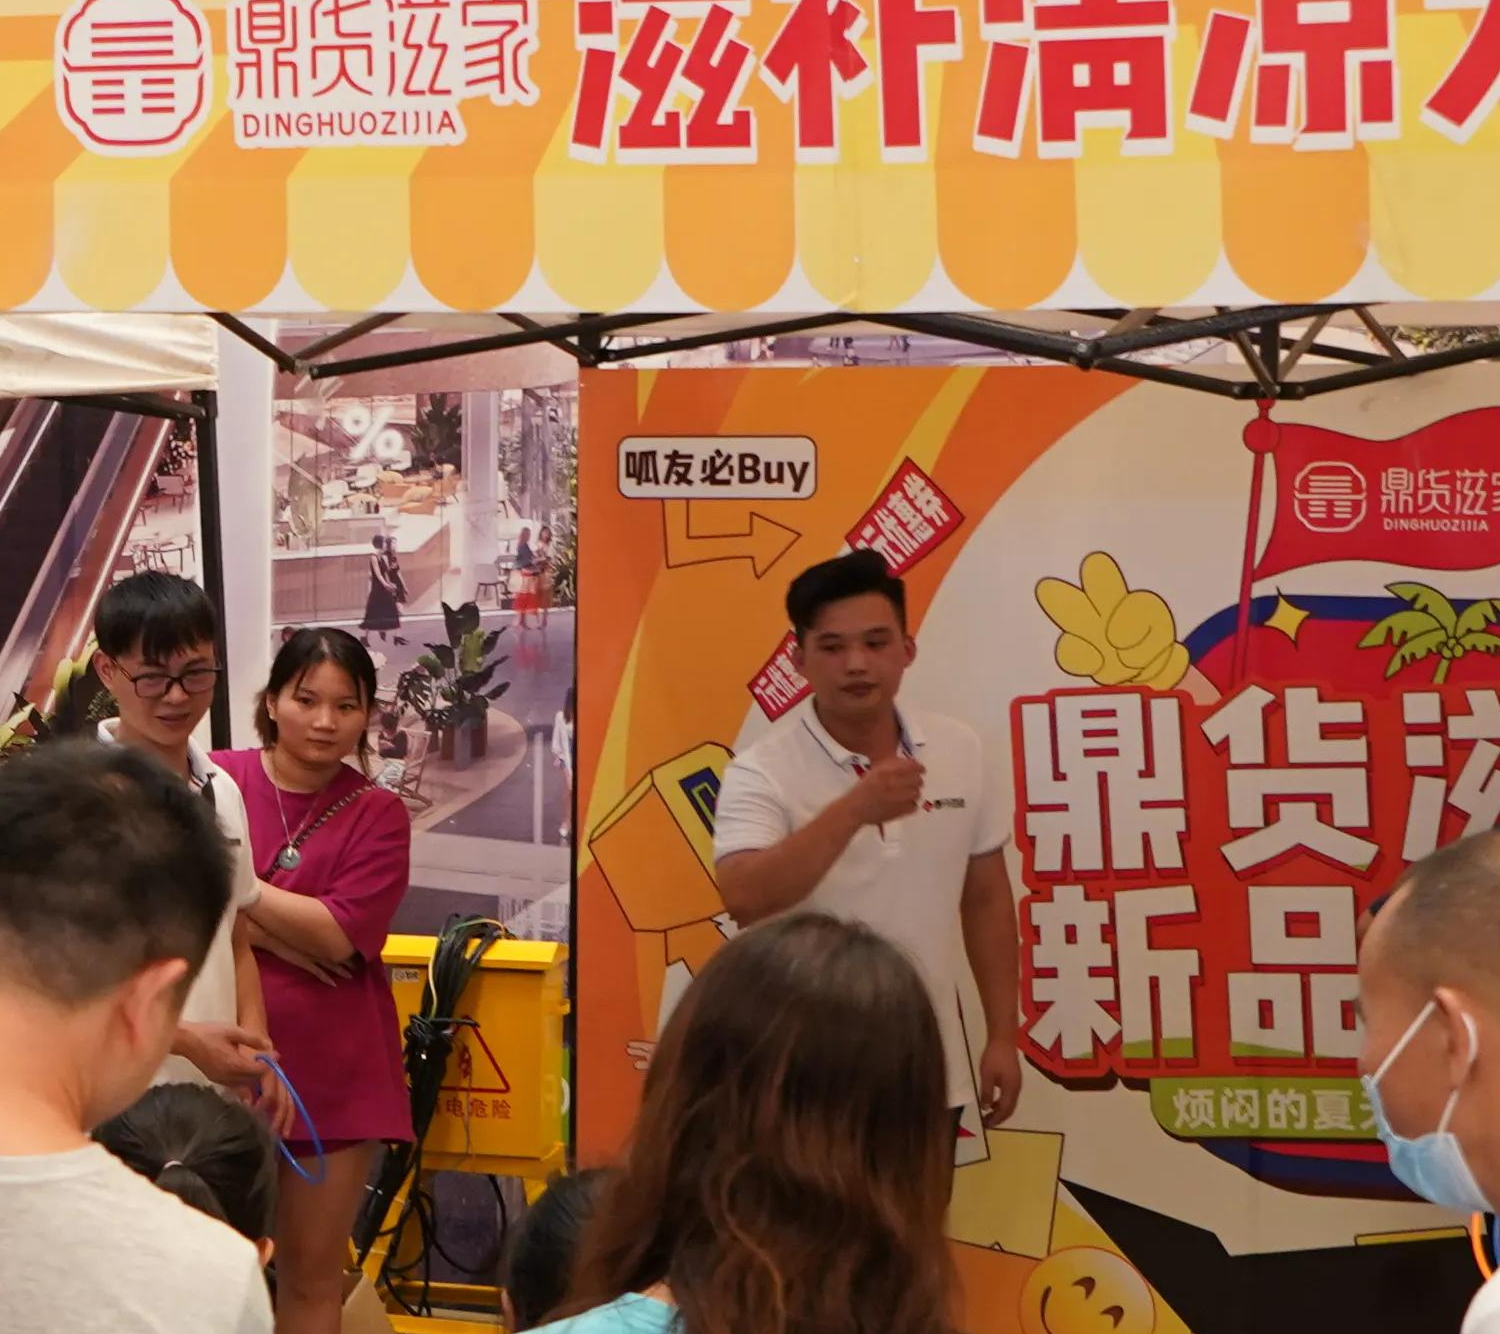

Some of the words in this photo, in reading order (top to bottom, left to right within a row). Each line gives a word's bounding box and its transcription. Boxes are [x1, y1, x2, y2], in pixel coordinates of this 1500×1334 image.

[242, 109, 457, 138] DINGHUOZIJIA
[1030, 883, 1358, 1063] 新品
[436, 1098, 512, 1119] 电危险
